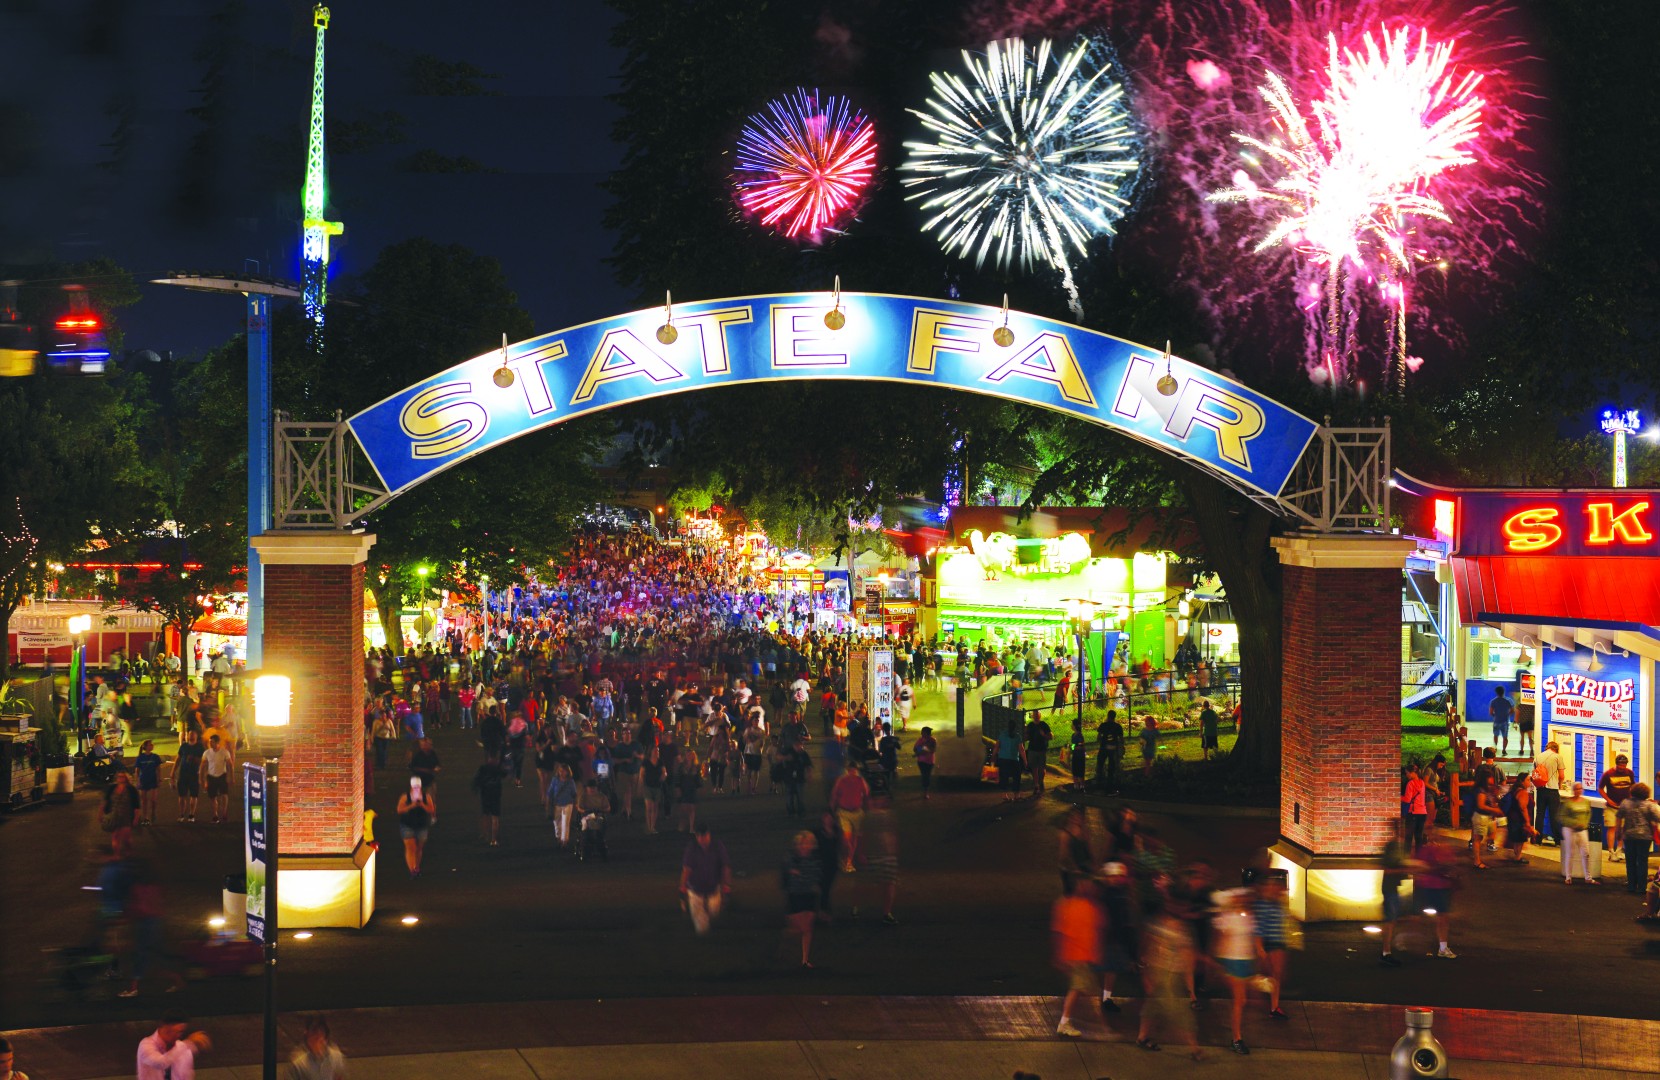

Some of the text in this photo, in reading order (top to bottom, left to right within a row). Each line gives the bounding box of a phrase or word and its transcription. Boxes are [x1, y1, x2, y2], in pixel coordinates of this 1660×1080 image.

[399, 304, 1266, 473] STATE FAIR
[1542, 673, 1635, 703] SKYRIDE
[1556, 698, 1569, 707] ONE
[1570, 699, 1584, 708] WAY
[1556, 707, 1578, 717] ROUND
[1580, 709, 1594, 719] TRIP
